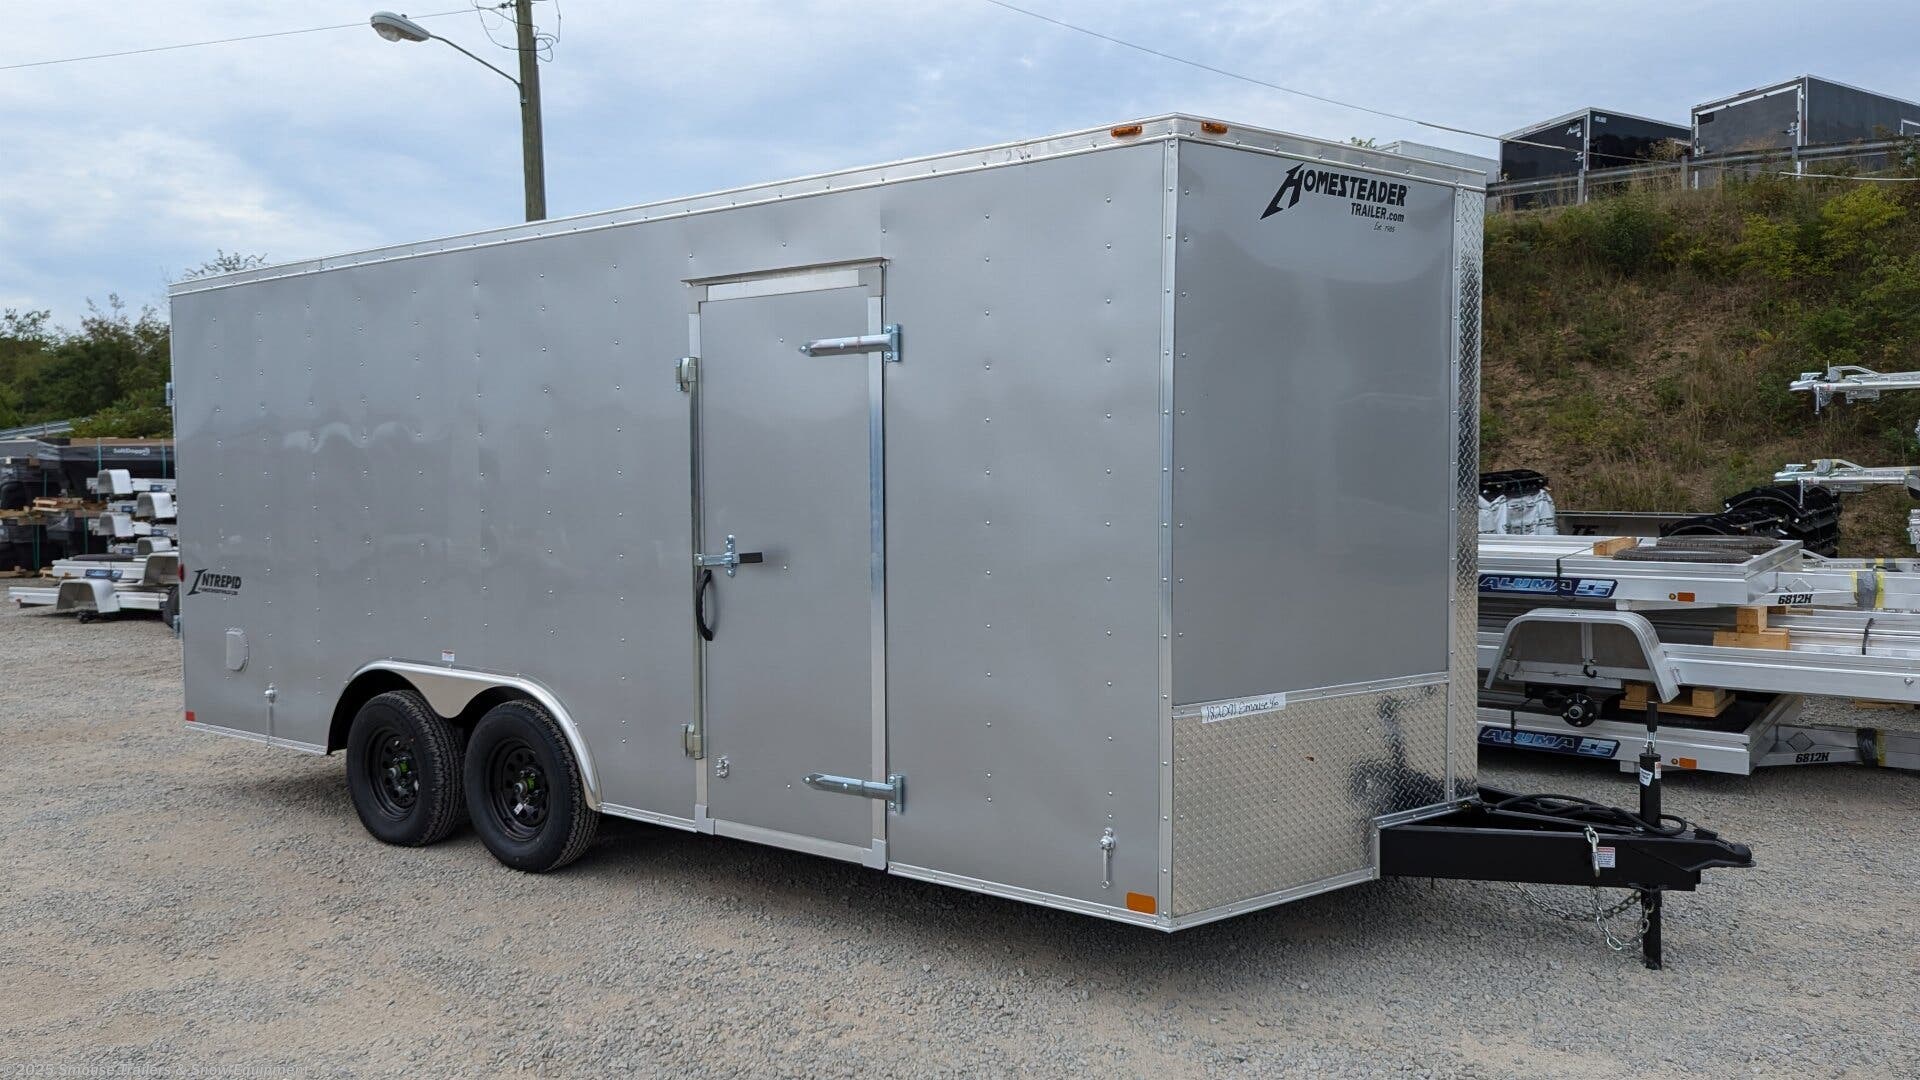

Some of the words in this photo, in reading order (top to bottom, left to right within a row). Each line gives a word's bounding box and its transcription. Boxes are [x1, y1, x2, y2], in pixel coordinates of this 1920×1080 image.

[1260, 163, 1407, 220] HOMESTEADER
[1351, 203, 1405, 222] TRAILER.com
[187, 568, 242, 596] INTREPID
[1480, 576, 1573, 592] ALUMA
[1778, 594, 1814, 604] 6812H
[1481, 729, 1575, 749] ALUMA
[1796, 752, 1830, 763] 6812H
